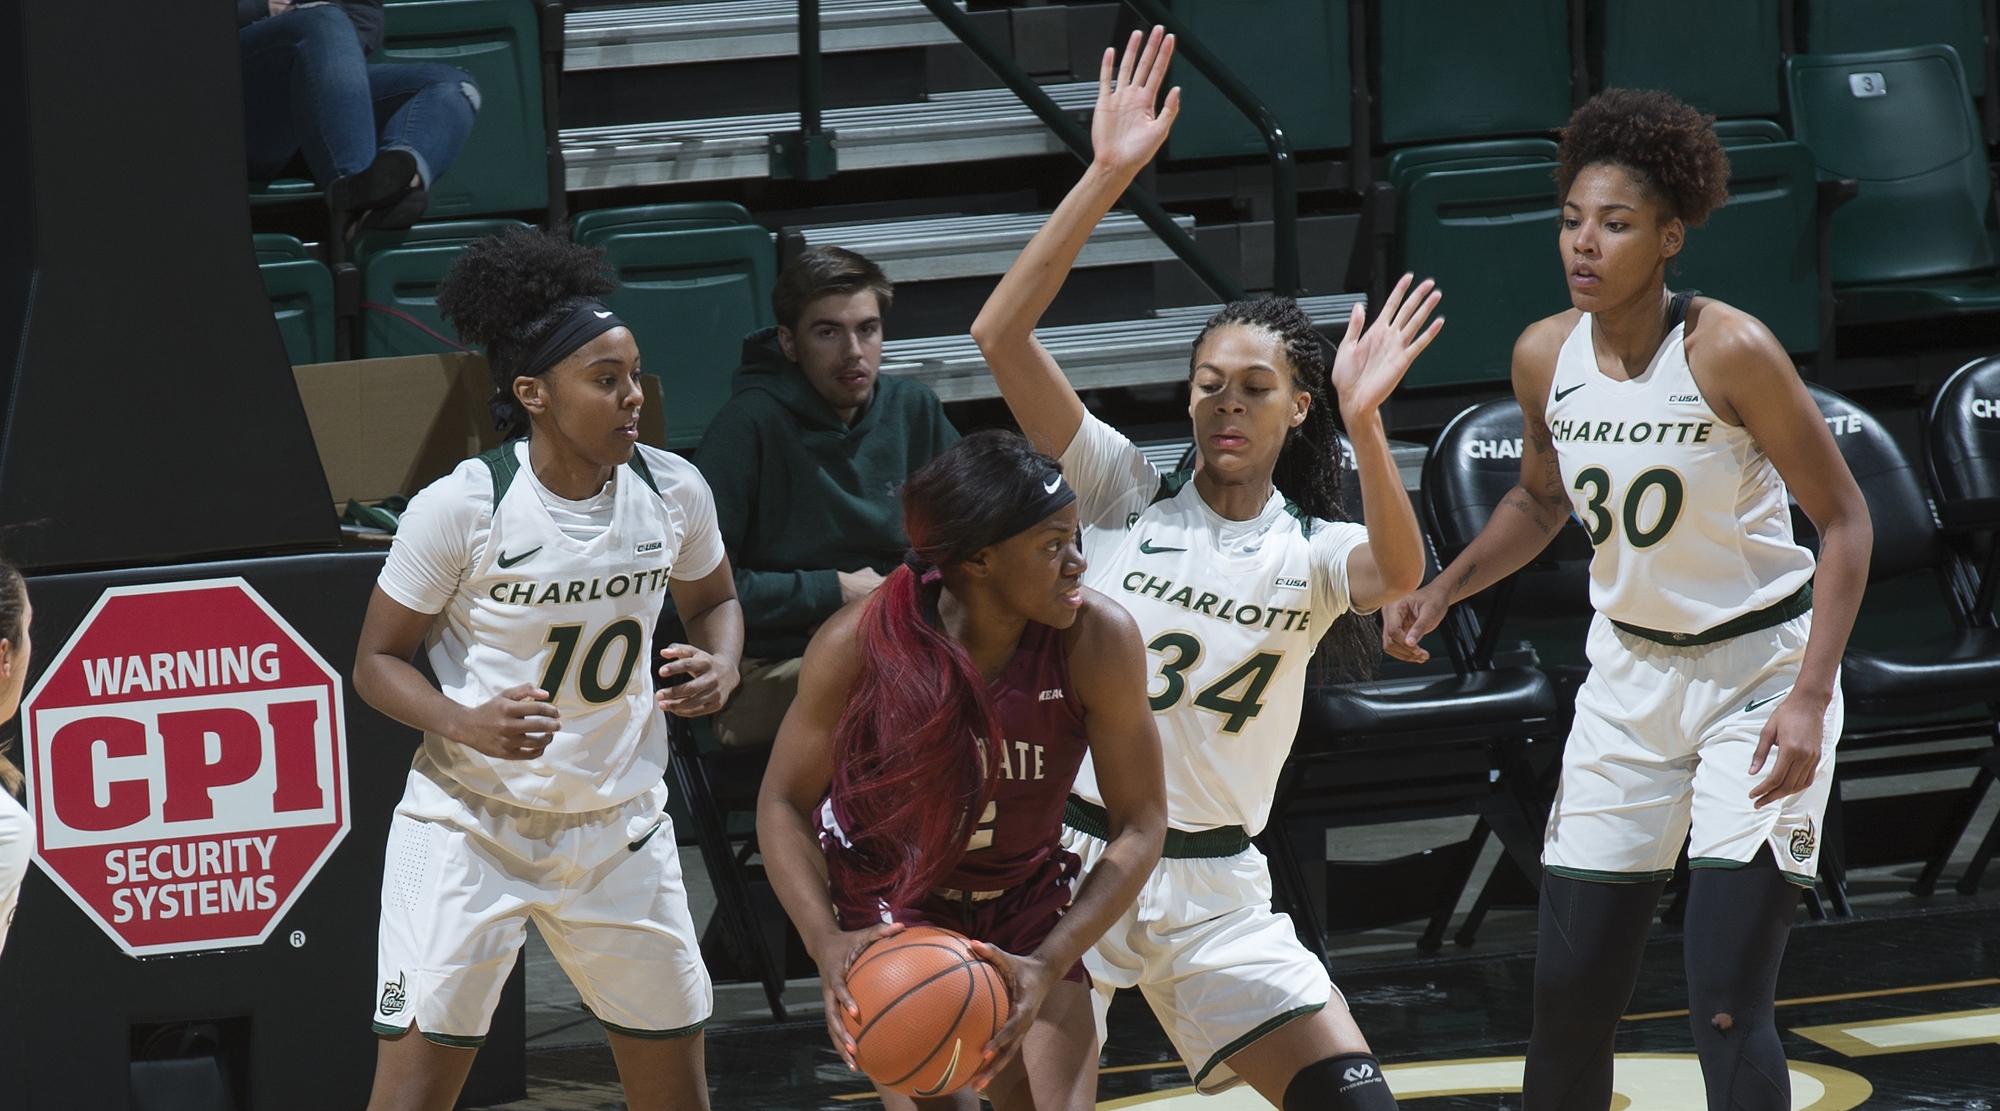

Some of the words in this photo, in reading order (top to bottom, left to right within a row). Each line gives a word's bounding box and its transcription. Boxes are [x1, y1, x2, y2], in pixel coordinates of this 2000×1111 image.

[1862, 76, 1874, 92] 3
[1552, 419, 1712, 445] CHARLOTTE
[1573, 464, 1687, 552] 30
[489, 566, 670, 606] CHARLOTTE
[1122, 571, 1310, 632] CHARLOTTE
[82, 643, 280, 697] WARNING
[535, 615, 643, 707] 10
[1146, 629, 1286, 737] 34
[50, 699, 324, 832] CPI
[104, 835, 278, 885] SECURITY
[112, 874, 277, 924] SYSTEMS
